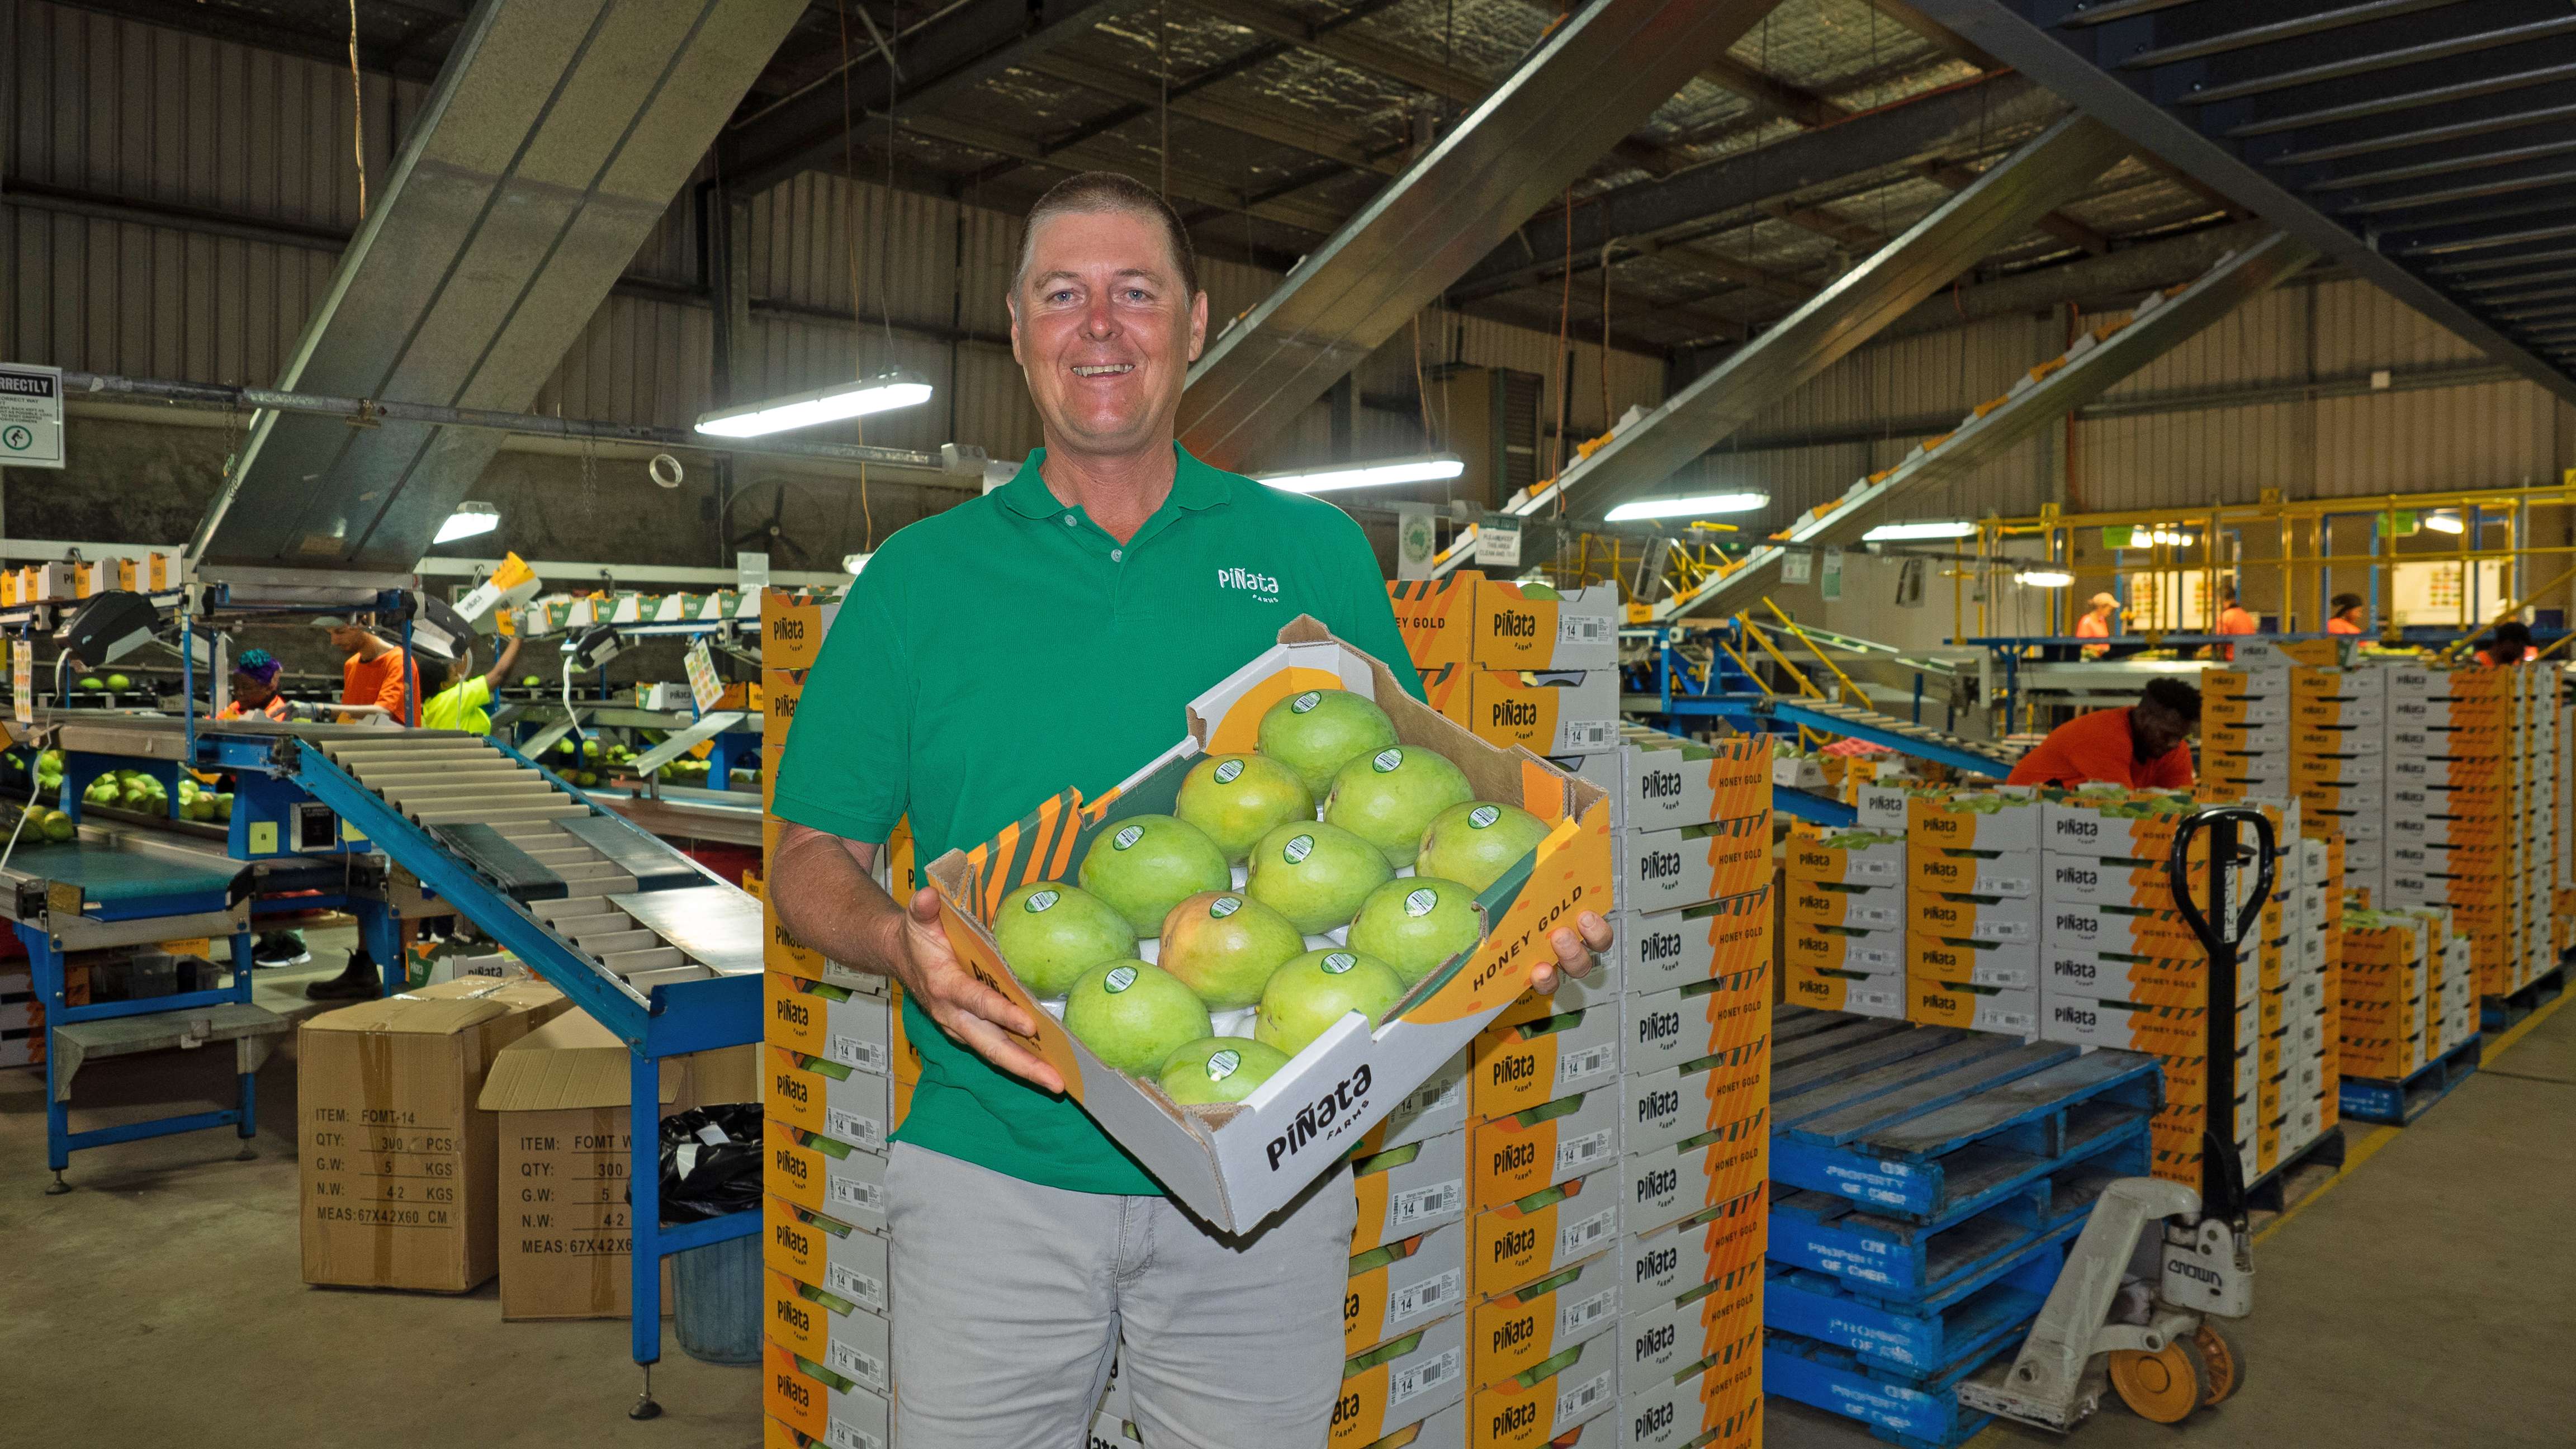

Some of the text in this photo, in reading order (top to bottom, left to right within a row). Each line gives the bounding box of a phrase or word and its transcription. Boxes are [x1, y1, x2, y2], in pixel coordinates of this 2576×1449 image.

[1253, 594, 1278, 603] FARMS
[1413, 618, 1445, 629] GOLD
[1566, 625, 1575, 636] 14
[1514, 642, 1532, 651] FARMS
[1515, 731, 1533, 740] FARMS
[1572, 731, 1580, 742] 14
[1720, 774, 1761, 787] HONEY GOLD
[1663, 801, 1679, 809] FARMS
[1719, 849, 1761, 864] HONEY GOLD
[1474, 886, 1582, 992] HONEY GOLD
[1720, 927, 1762, 944] HONEY GOLD
[1718, 1001, 1760, 1020] HONEY GOLD
[840, 1045, 848, 1055] 14
[1569, 1063, 1578, 1074] 14
[1717, 1074, 1759, 1096] HONEY GOLD
[1401, 1099, 1412, 1112] 14
[316, 1109, 414, 1125] ITEM: FOMT-14
[1327, 1100, 1368, 1140] FARMS
[835, 1120, 843, 1130] 14
[316, 1134, 452, 1151] QTY: 300 PCS
[521, 1137, 559, 1151] ITEM:
[575, 1136, 614, 1148] FOMT
[1565, 1151, 1574, 1162] 14
[1715, 1148, 1758, 1172] HONEY GOLD
[316, 1158, 452, 1176] G.W: 5 KGS
[521, 1163, 622, 1177] QTY: 300
[317, 1183, 344, 1196] N.W:
[427, 1188, 453, 1201] KGS
[522, 1188, 609, 1202] G.W: 5
[838, 1185, 846, 1196] 14
[1404, 1202, 1414, 1215] 14
[318, 1207, 447, 1224] MEAS: 67X42X60 CM
[522, 1215, 555, 1228] N.W:
[1570, 1234, 1579, 1246] 14
[1716, 1222, 1757, 1247] HONEY GOLD
[522, 1238, 632, 1254] MEAS: 67X42X6
[837, 1274, 845, 1285] 14
[2168, 1260, 2222, 1287] CROWN
[1401, 1298, 1412, 1311] 14
[1712, 1294, 1753, 1322] HONEY GOLD
[1570, 1314, 1579, 1325] 14
[839, 1352, 847, 1363] 14
[1402, 1377, 1412, 1392] 14
[1710, 1367, 1752, 1397] HONEY GOLD
[1565, 1401, 1573, 1412] 14
[837, 1429, 845, 1440] 14
